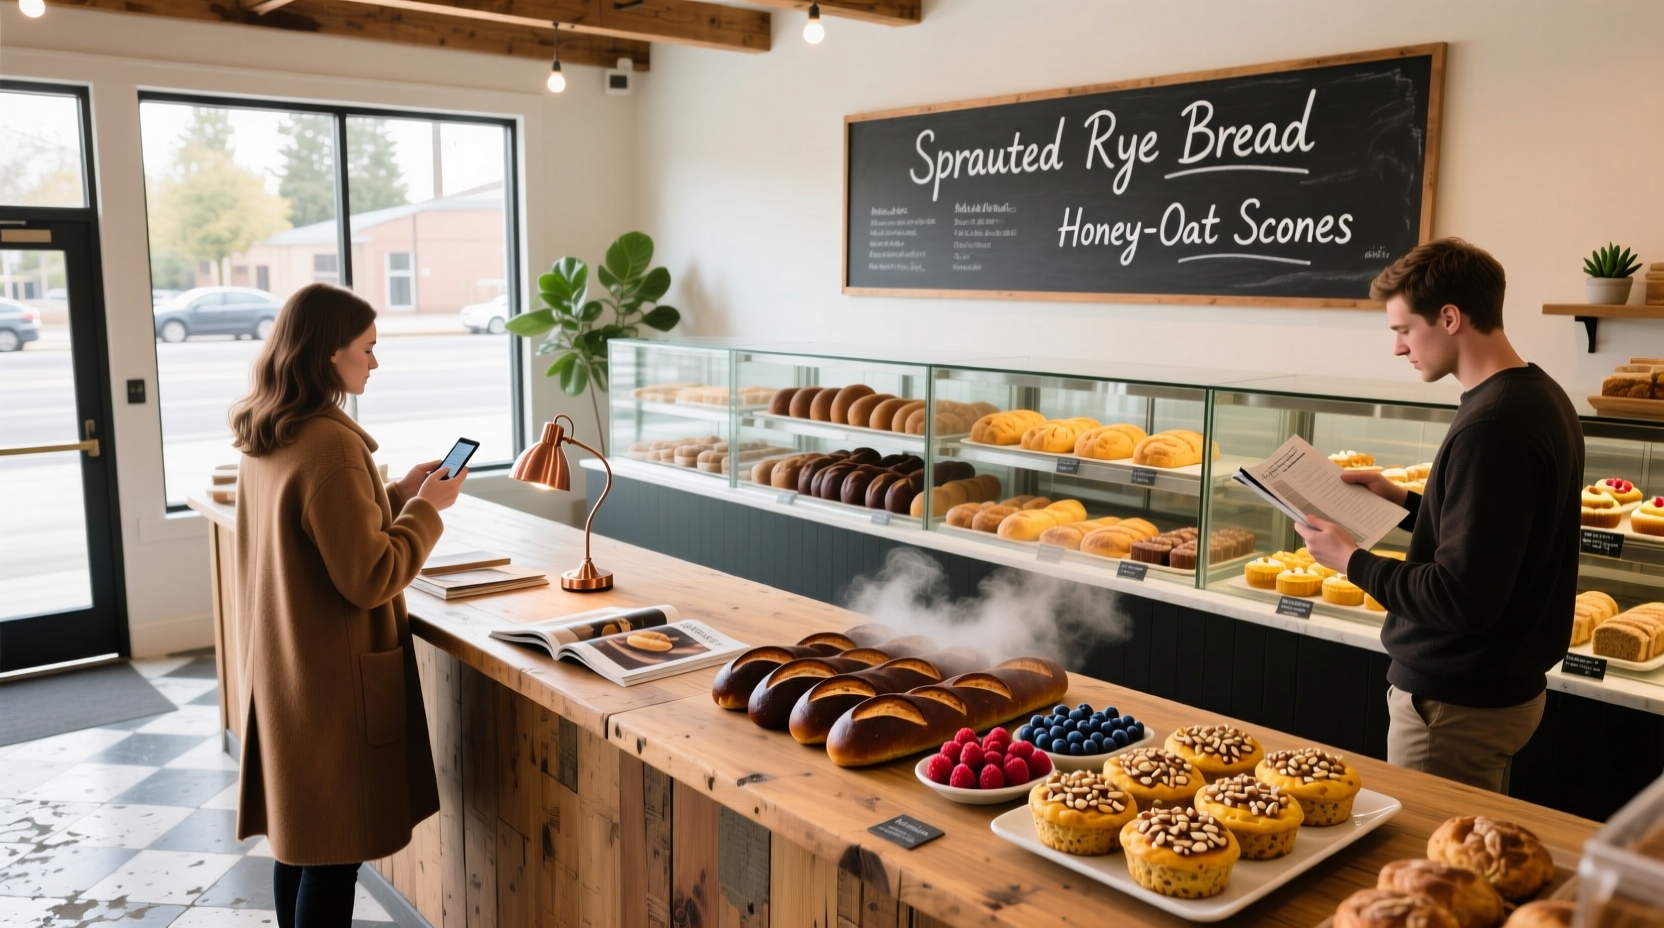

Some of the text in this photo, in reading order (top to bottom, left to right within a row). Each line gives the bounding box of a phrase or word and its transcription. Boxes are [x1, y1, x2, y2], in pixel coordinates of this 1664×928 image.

[909, 88, 1317, 202] Sprauted Rye Bread
[1057, 197, 1354, 266] Honey-Oat Scones
